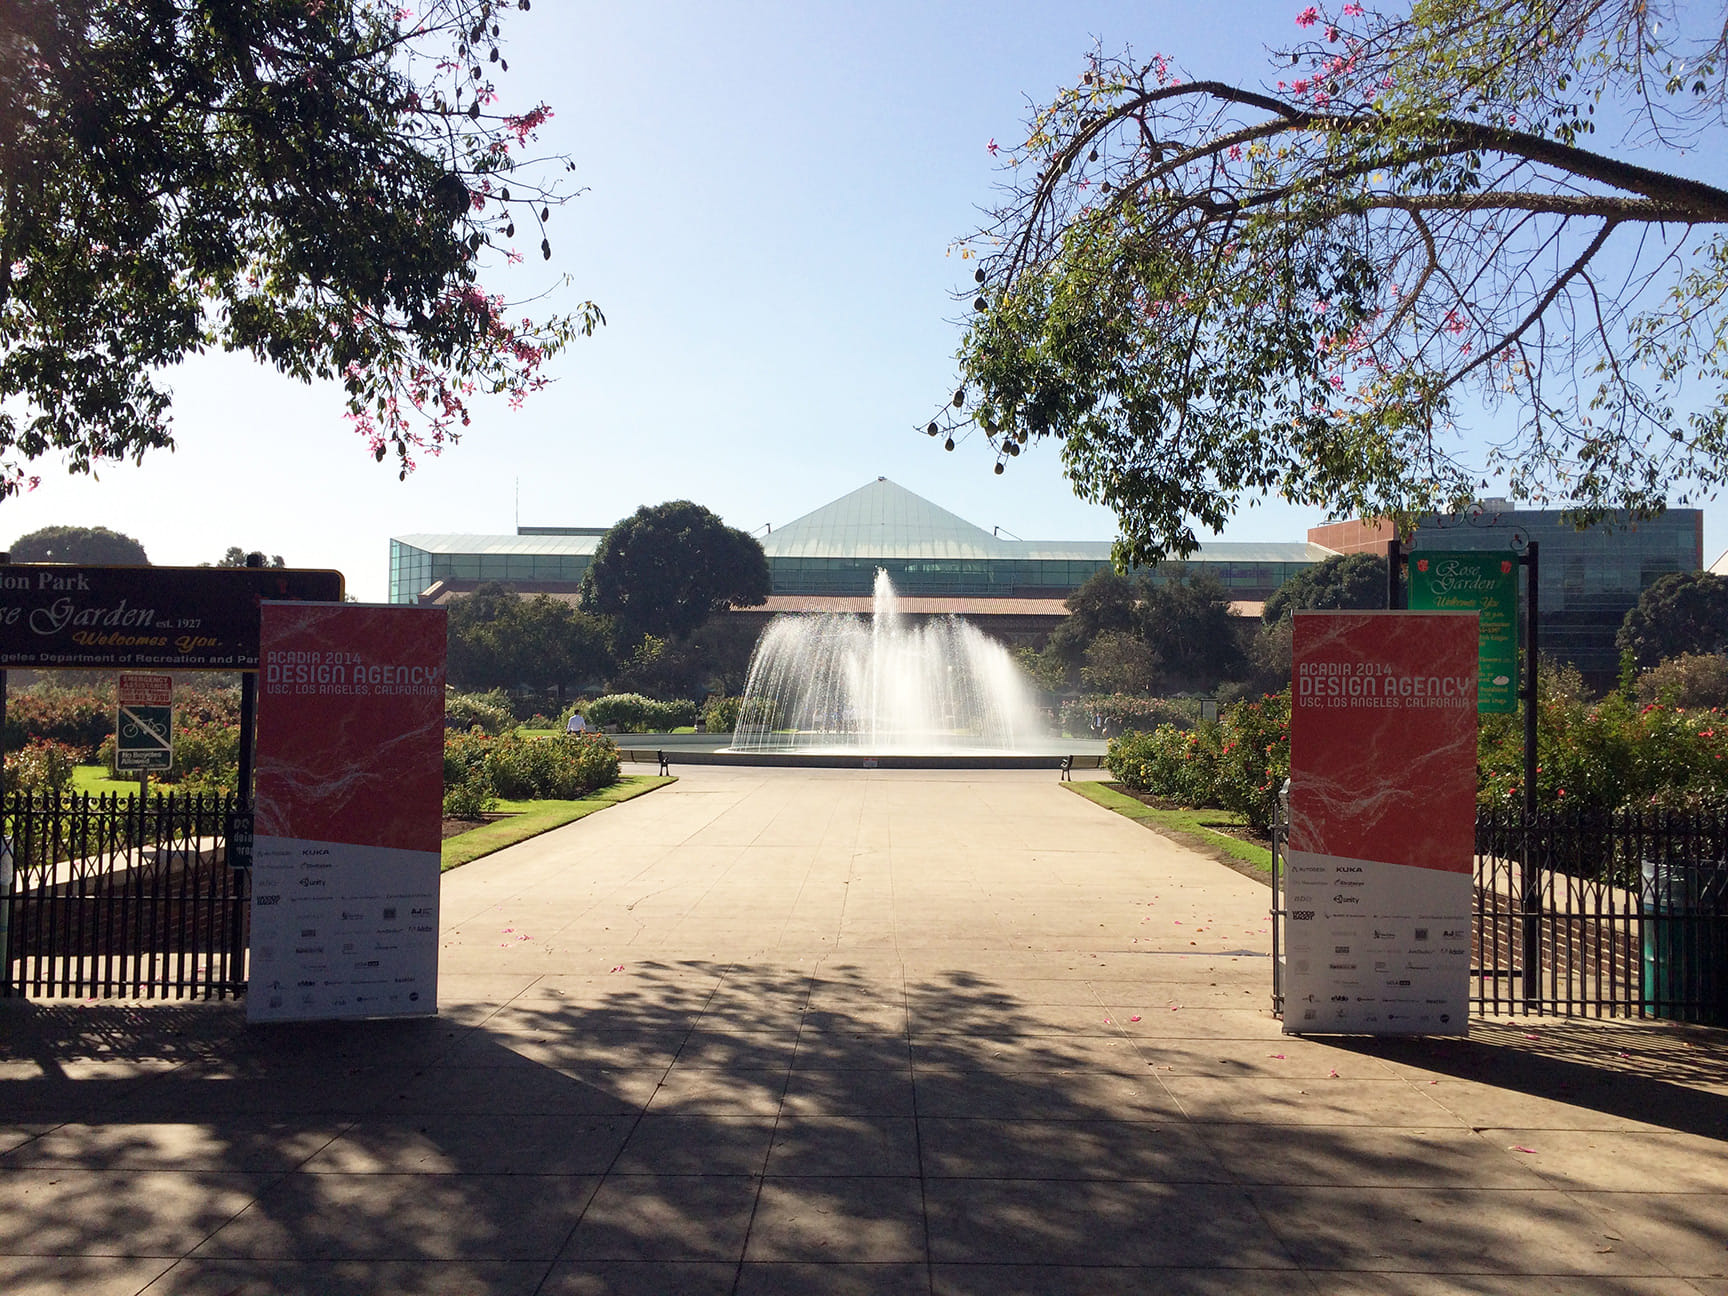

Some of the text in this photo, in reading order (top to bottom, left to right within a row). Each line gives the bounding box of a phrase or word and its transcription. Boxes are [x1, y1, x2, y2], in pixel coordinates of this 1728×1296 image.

[1435, 560, 1480, 577] Rose
[39, 572, 90, 590] Park
[1431, 574, 1496, 595] Garden
[29, 597, 155, 636] Garden
[177, 619, 201, 629] 1927
[72, 631, 168, 647] Welcomes
[40, 654, 114, 663] Department
[119, 654, 131, 663] of
[135, 654, 205, 664] Recreation
[209, 655, 233, 664] and
[267, 651, 361, 665] ACADIA 2014
[267, 664, 438, 684] DESIGN AGENCY
[1300, 663, 1393, 676] ACADIA 2014
[267, 684, 438, 696] USC, LOS ANGELES, CALIFORNIA
[1300, 677, 1376, 696] DESIGN
[1384, 677, 1469, 696] AGENCY
[1300, 697, 1324, 709] USC,
[1327, 697, 1348, 707] LOS
[1351, 697, 1402, 709] ANGELES,
[1405, 697, 1470, 709] CALIFORNIA
